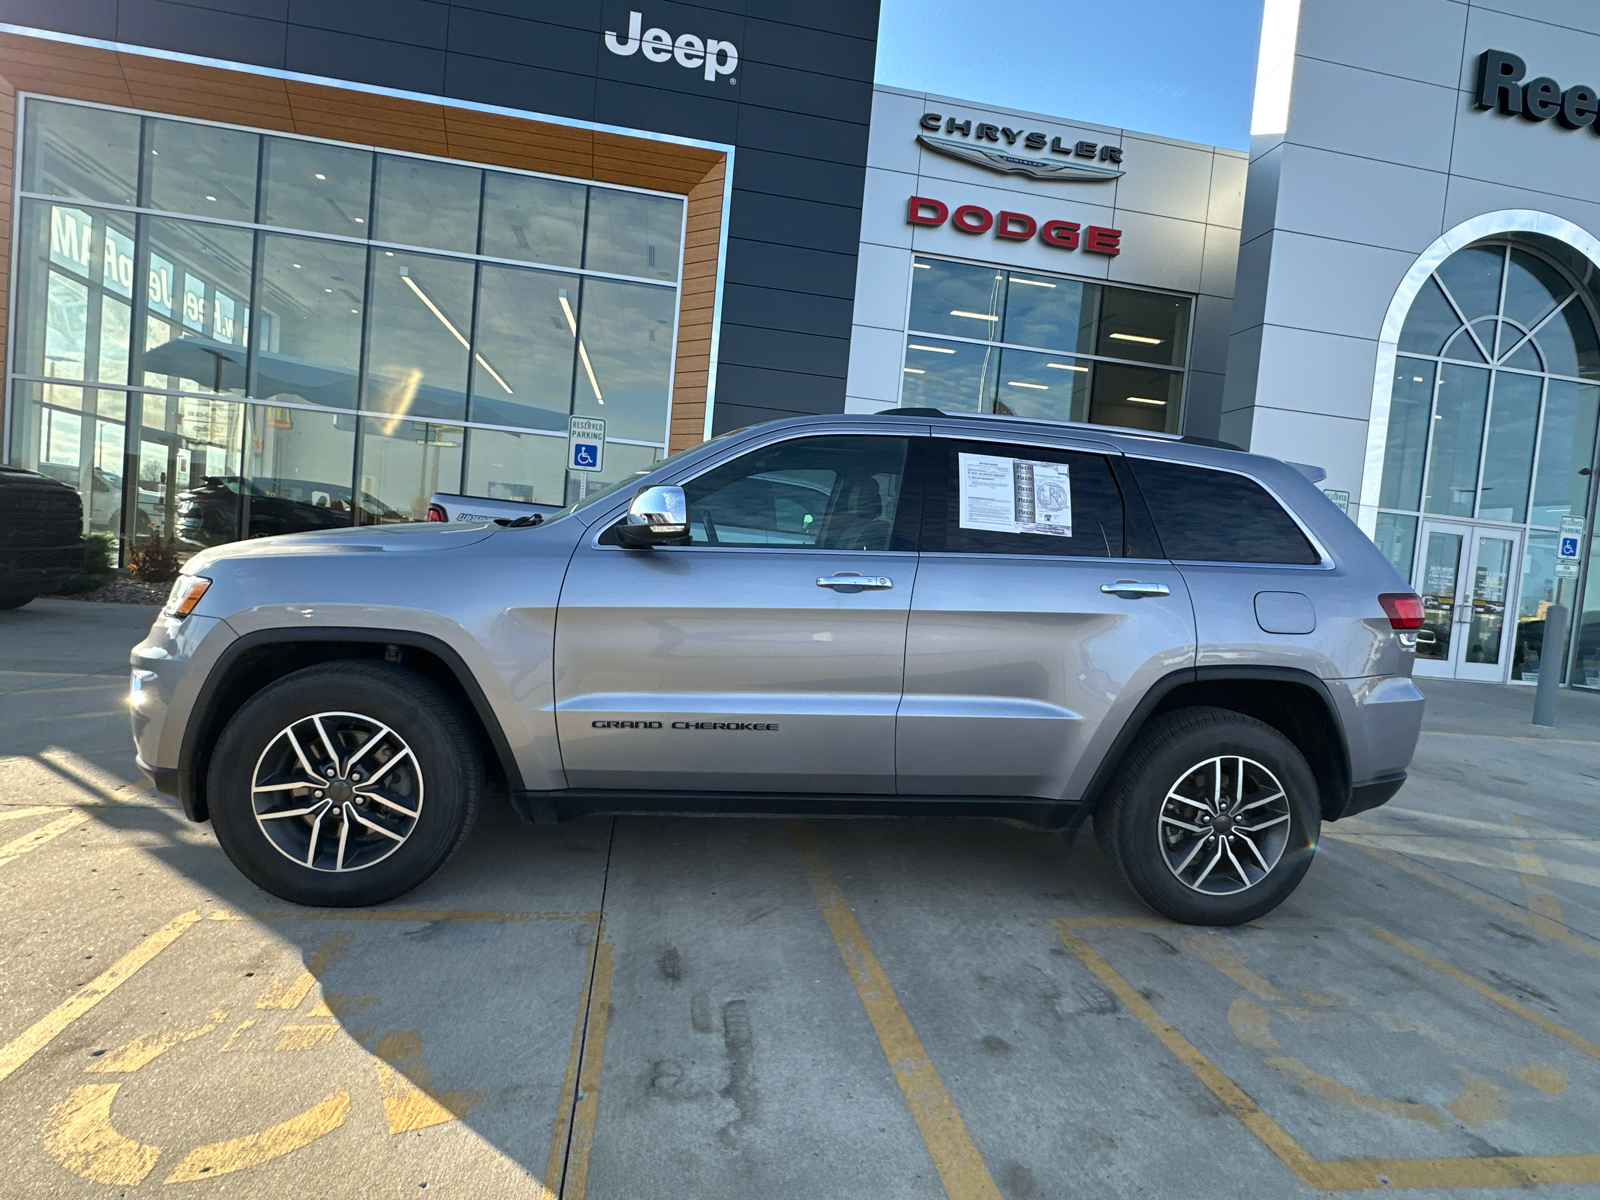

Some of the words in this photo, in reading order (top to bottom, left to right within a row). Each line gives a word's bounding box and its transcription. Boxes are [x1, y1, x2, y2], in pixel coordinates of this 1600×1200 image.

[604, 11, 739, 82] Jeep
[1475, 48, 1600, 134] Ree
[920, 113, 1124, 163] CHRYSLER
[1002, 156, 1043, 167] CHRYSLER
[907, 195, 1123, 257] DODGE
[571, 430, 603, 441] PARKING
[572, 420, 603, 431] RESERVED
[591, 720, 663, 729] GRAND
[671, 721, 779, 731] CHEROKEE
